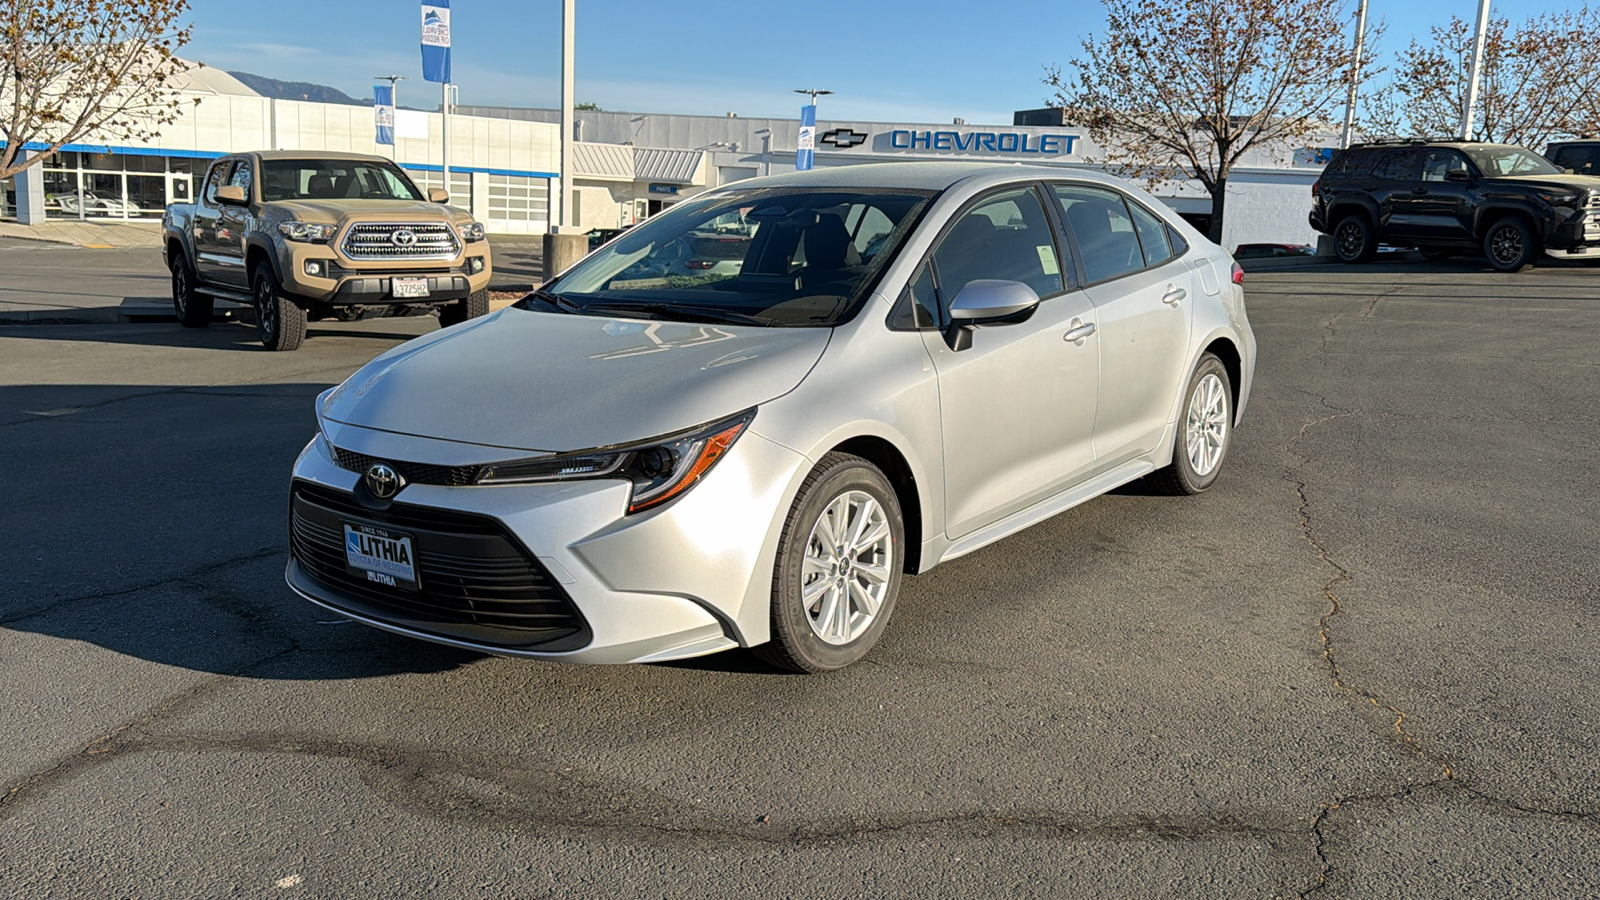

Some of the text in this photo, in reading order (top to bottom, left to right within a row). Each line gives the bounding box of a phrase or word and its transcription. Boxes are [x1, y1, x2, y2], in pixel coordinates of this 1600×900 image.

[891, 130, 1081, 154] CHEVROLET
[360, 526, 376, 534] SINCE
[359, 534, 411, 566] LITHIA
[349, 553, 373, 565] TOYOTA
[383, 561, 412, 576] REDDING
[373, 572, 396, 586] LITHIA
